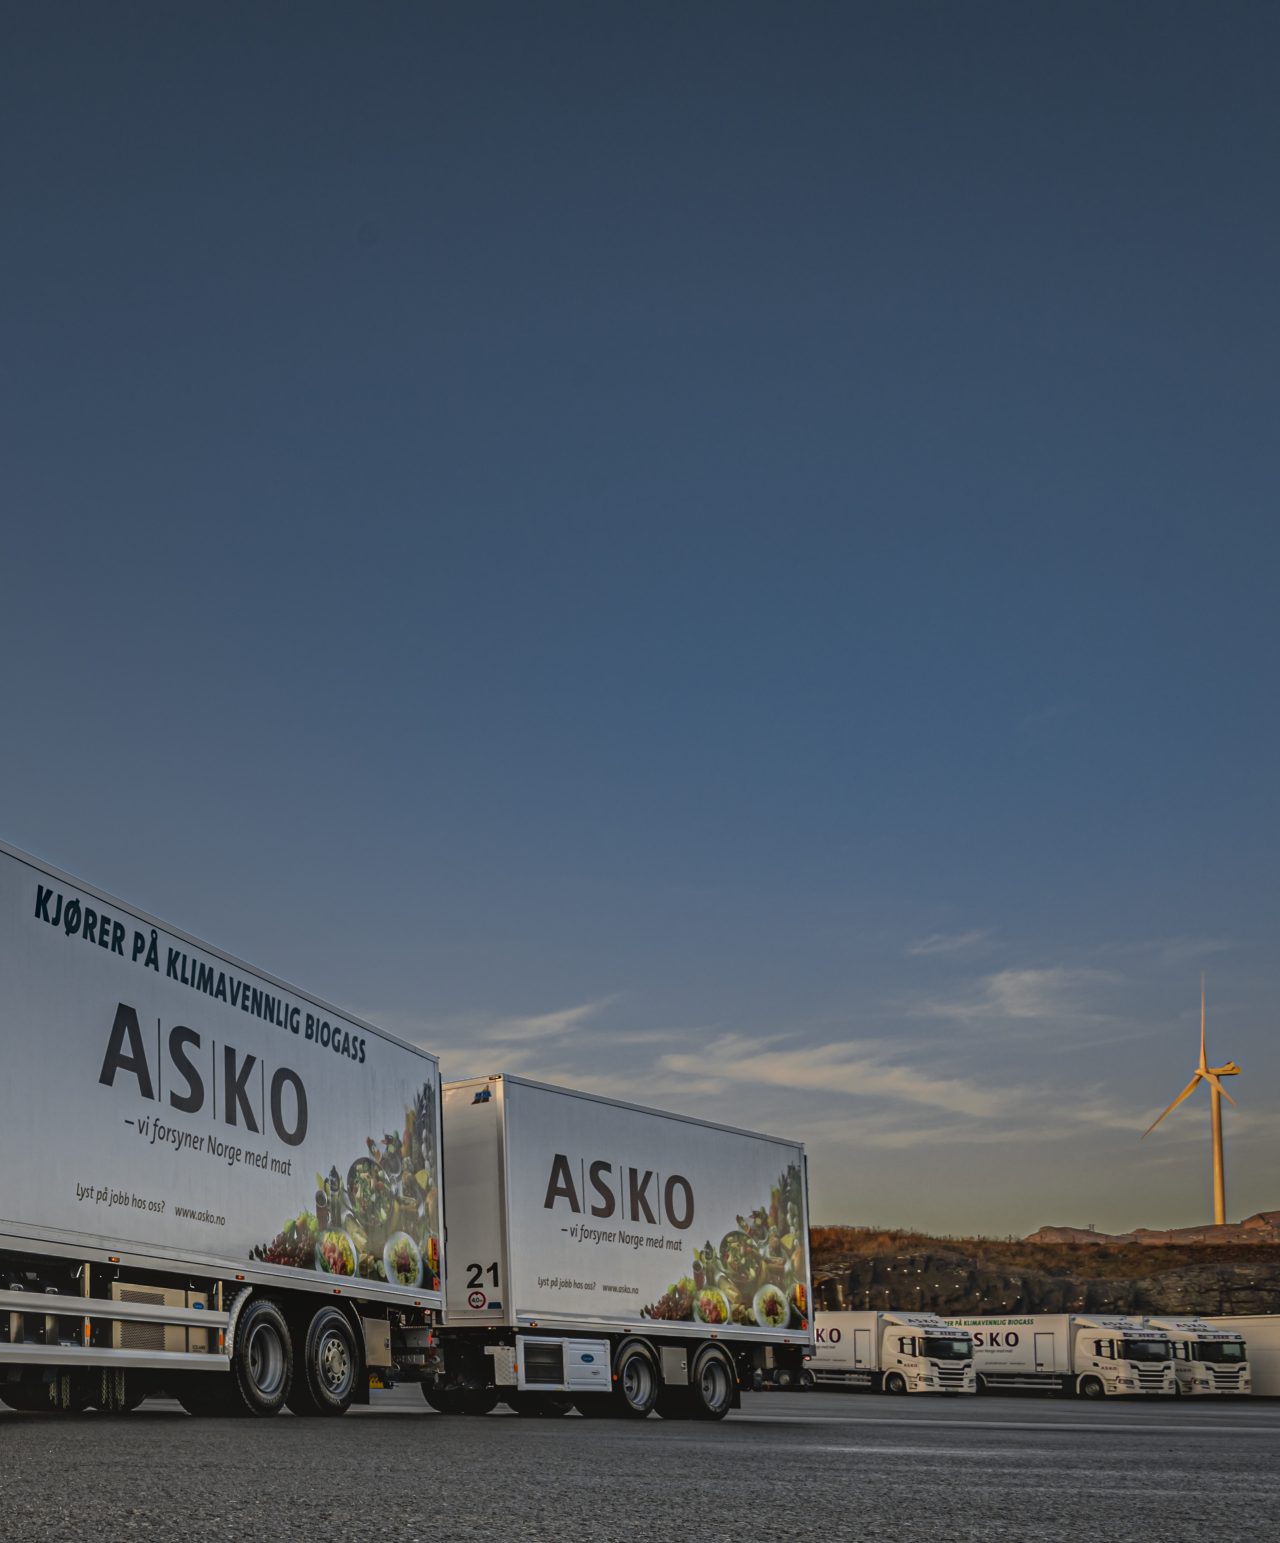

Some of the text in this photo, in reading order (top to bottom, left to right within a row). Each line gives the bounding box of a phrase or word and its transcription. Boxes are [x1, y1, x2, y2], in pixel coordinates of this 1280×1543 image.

[35, 884, 366, 1064] KJØRER PÅ KLIMAVENNLIG BIOGASS
[98, 1002, 308, 1147] ASKO
[138, 1115, 149, 1136] vi
[150, 1118, 204, 1151] forsyner
[207, 1135, 241, 1166] Norge
[245, 1150, 268, 1170] med
[271, 1157, 292, 1176] mat
[76, 1183, 165, 1213] Lyst på jobb hos oss?
[544, 1153, 694, 1230] ASKO
[175, 1206, 226, 1226] www.asko.no
[570, 1224, 578, 1237] vi
[578, 1224, 616, 1245] forsyner
[619, 1230, 644, 1250] Norge
[646, 1235, 664, 1249] med
[666, 1239, 682, 1251] mat
[466, 1262, 499, 1288] 21
[816, 1328, 841, 1344] KO
[974, 1332, 1020, 1348] SKO
